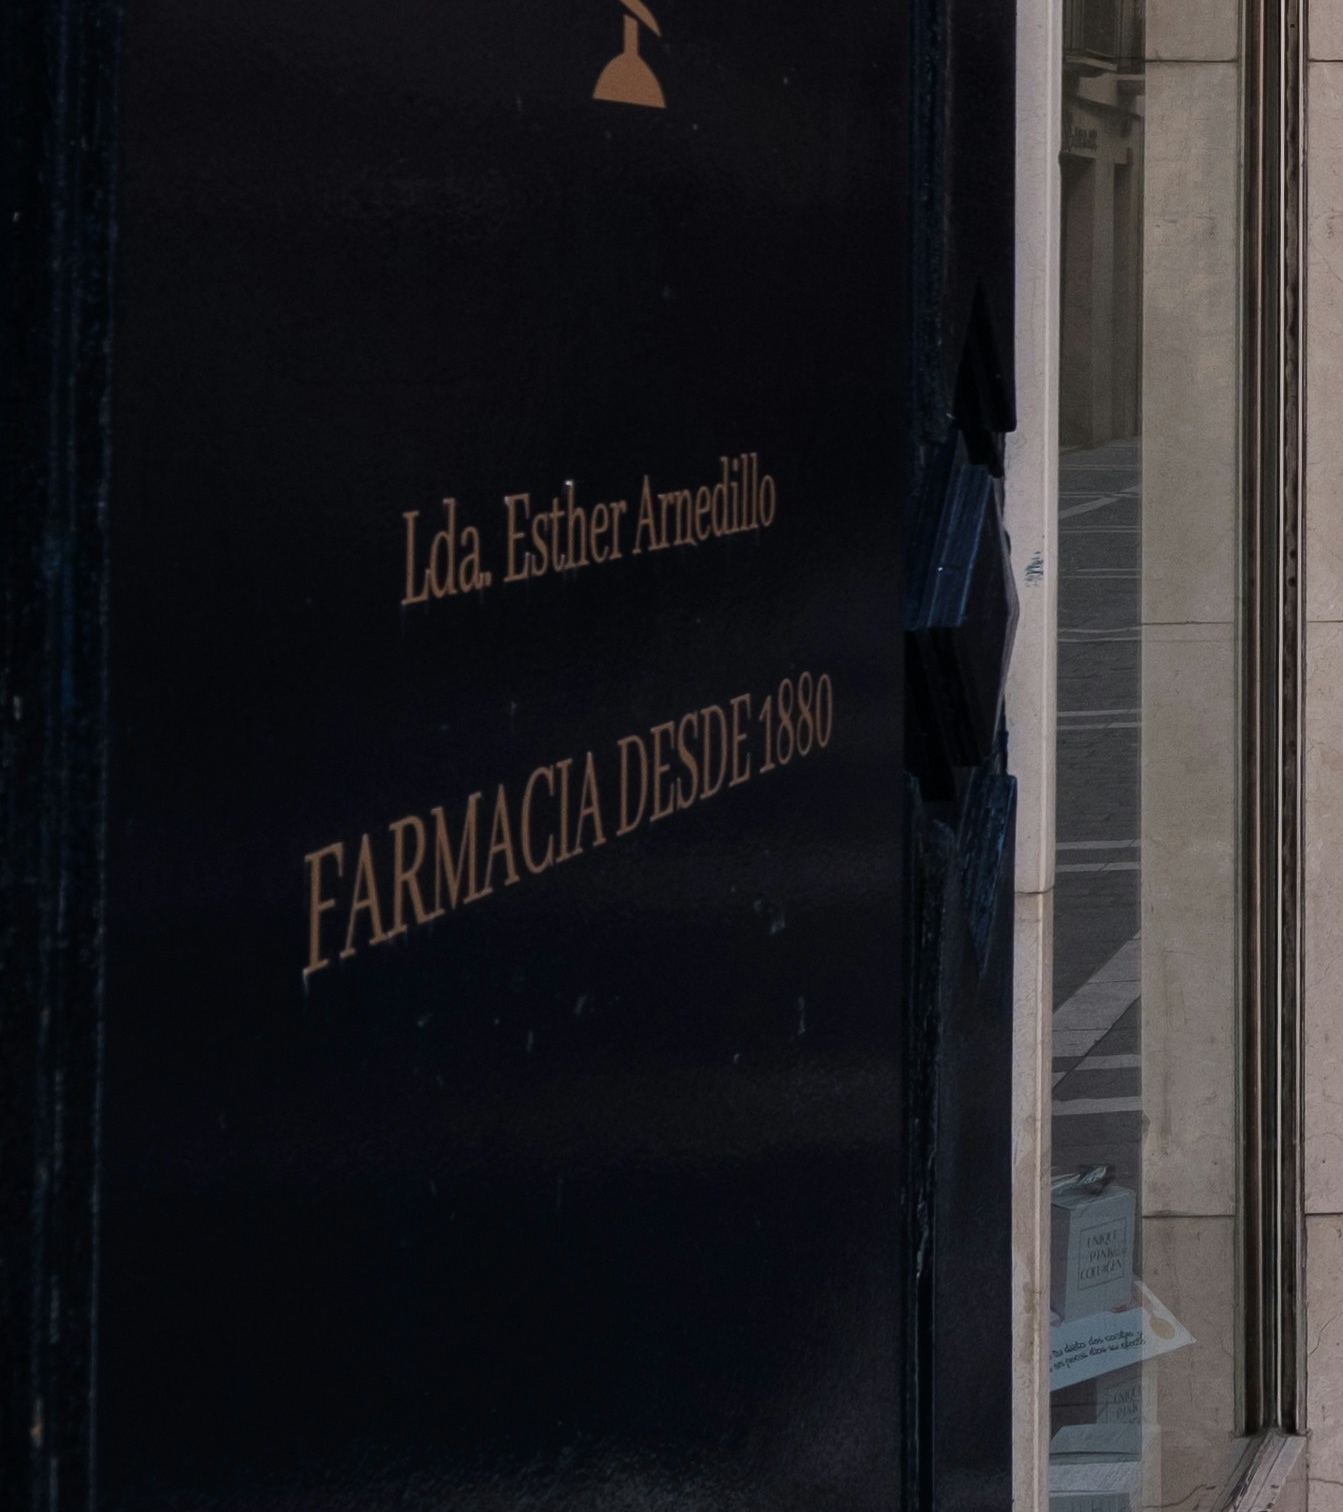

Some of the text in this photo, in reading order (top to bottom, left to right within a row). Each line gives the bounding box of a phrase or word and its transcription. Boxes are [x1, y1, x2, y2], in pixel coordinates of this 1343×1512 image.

[401, 453, 776, 605] Lda. Esther Arnedillo
[302, 671, 834, 976] FARMACIA DESDE 1880
